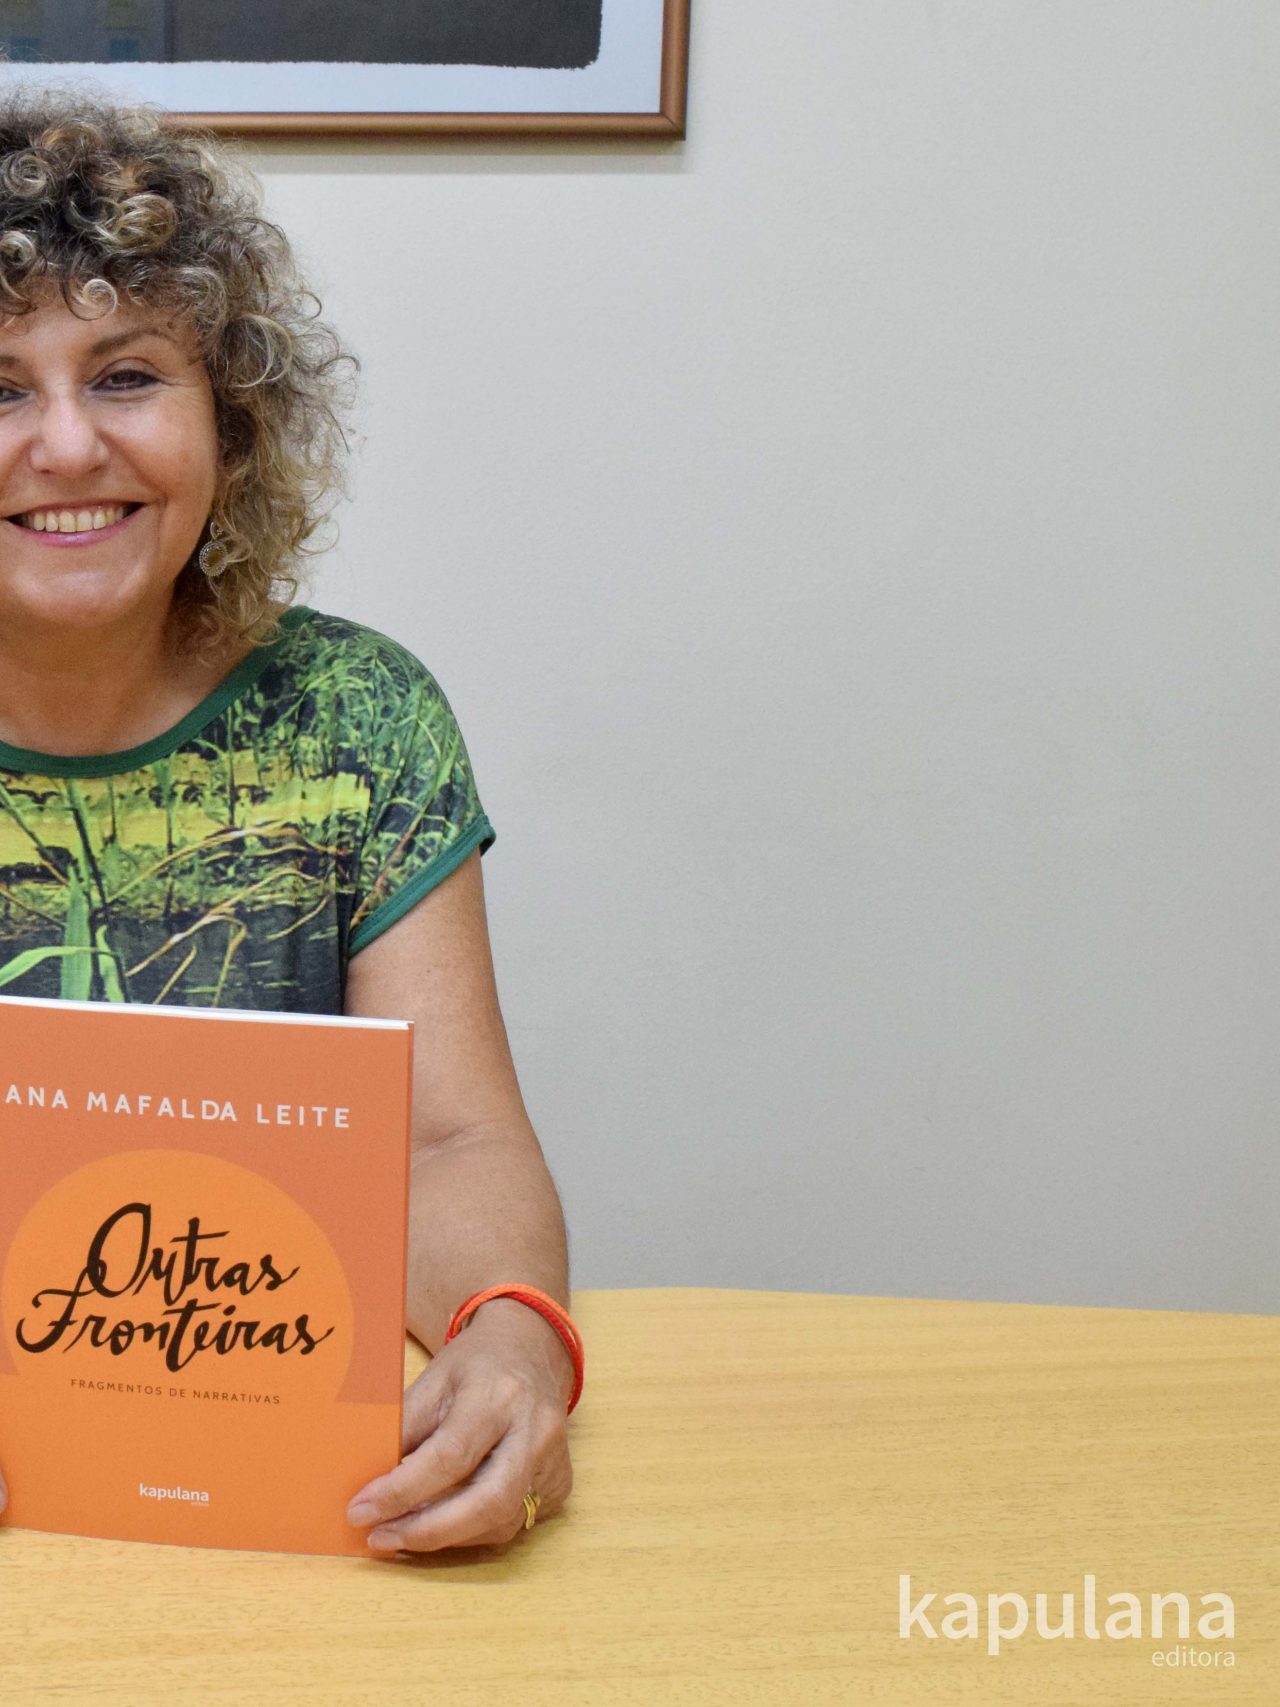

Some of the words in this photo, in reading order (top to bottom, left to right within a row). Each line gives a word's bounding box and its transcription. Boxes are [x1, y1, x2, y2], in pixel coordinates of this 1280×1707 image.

[5, 1084, 69, 1109] ANA
[86, 1091, 238, 1122] MAFALDA
[256, 1105, 351, 1129] LEITE
[86, 1201, 301, 1307] Outras
[16, 1276, 335, 1373] Fronteiras
[70, 1378, 163, 1396] FRAGMENTOS
[169, 1387, 186, 1398] DE
[193, 1389, 281, 1405] NARRATIVAS
[139, 1482, 209, 1502] kapulana
